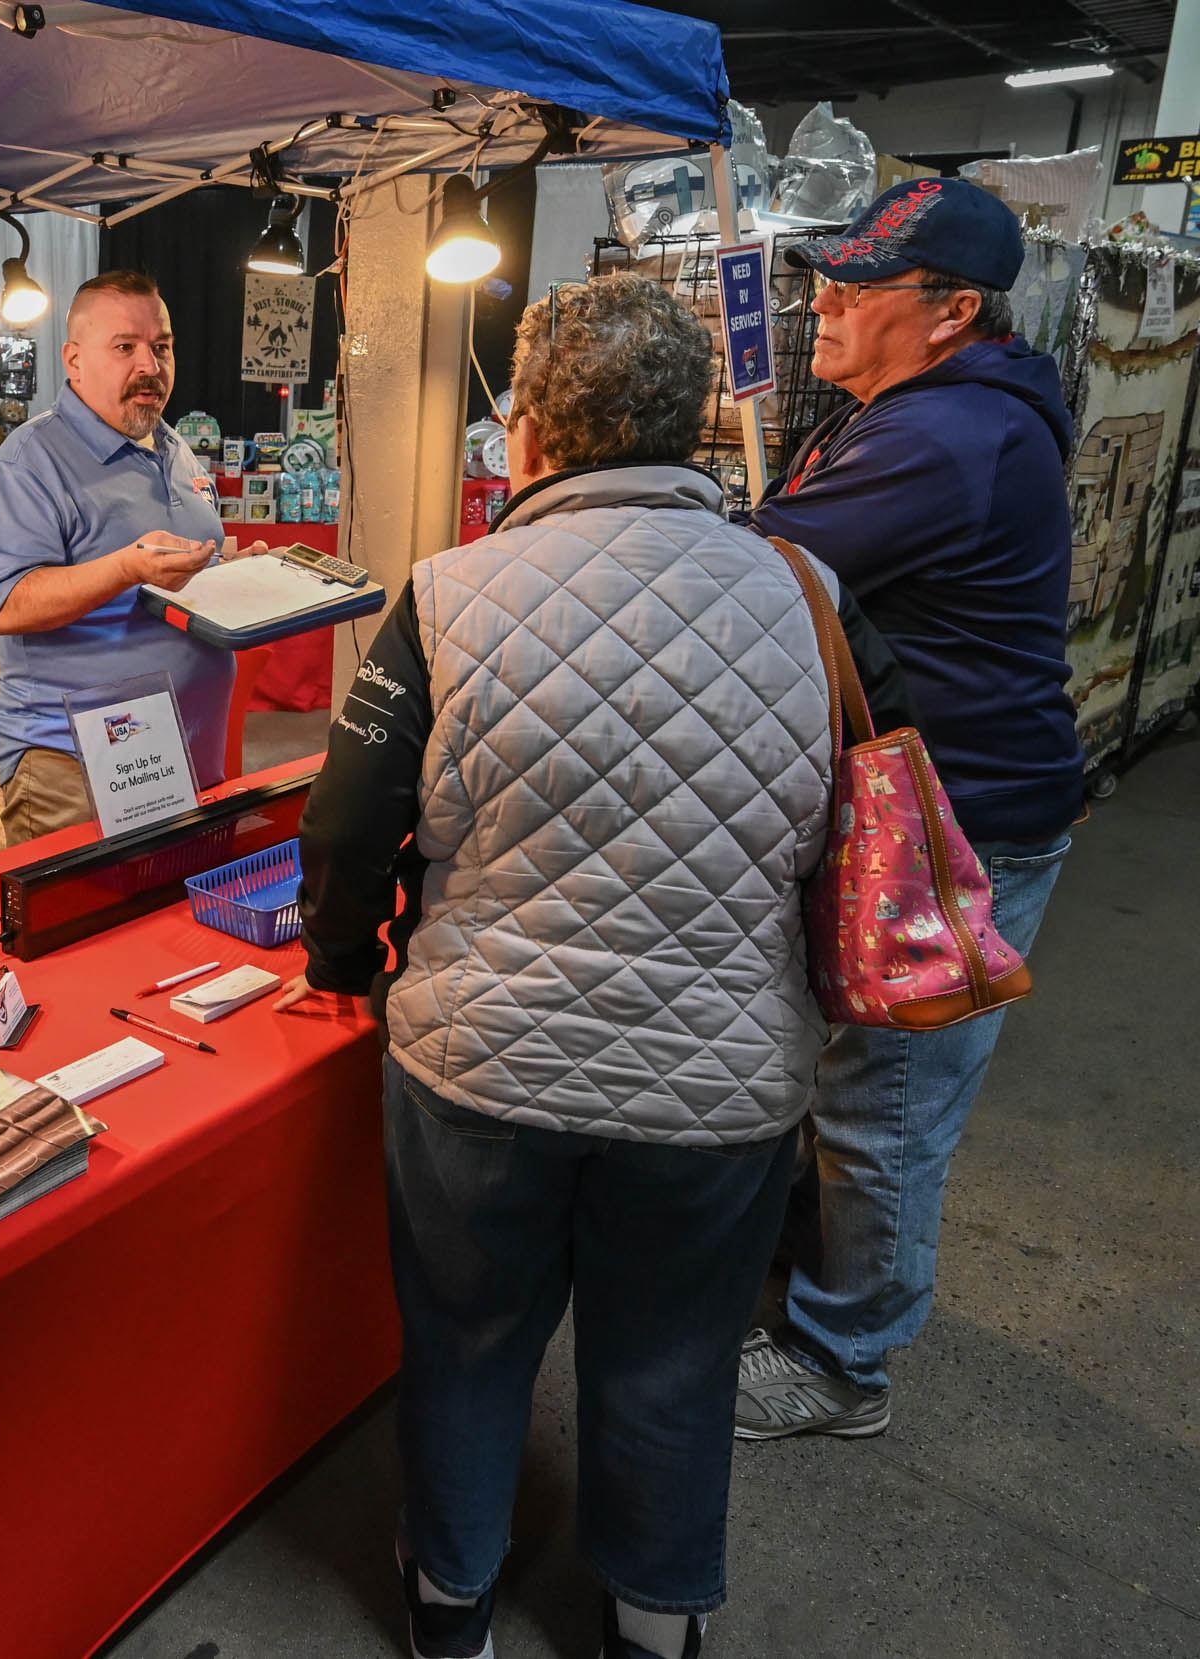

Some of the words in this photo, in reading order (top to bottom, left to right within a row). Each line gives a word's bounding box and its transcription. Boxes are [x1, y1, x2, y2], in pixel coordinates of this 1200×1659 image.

[821, 239, 875, 266] LAS
[865, 180, 943, 239] VEGAS
[732, 263, 751, 281] NEED
[739, 288, 749, 305] RV
[730, 310, 762, 333] SERVICE?
[114, 725, 128, 738] USA
[364, 722, 388, 745] 50
[115, 762, 135, 775] Sign
[135, 758, 149, 771] Up
[149, 753, 162, 765] for
[109, 781, 127, 793] Our
[128, 770, 160, 788] Mailing
[160, 765, 176, 777] List
